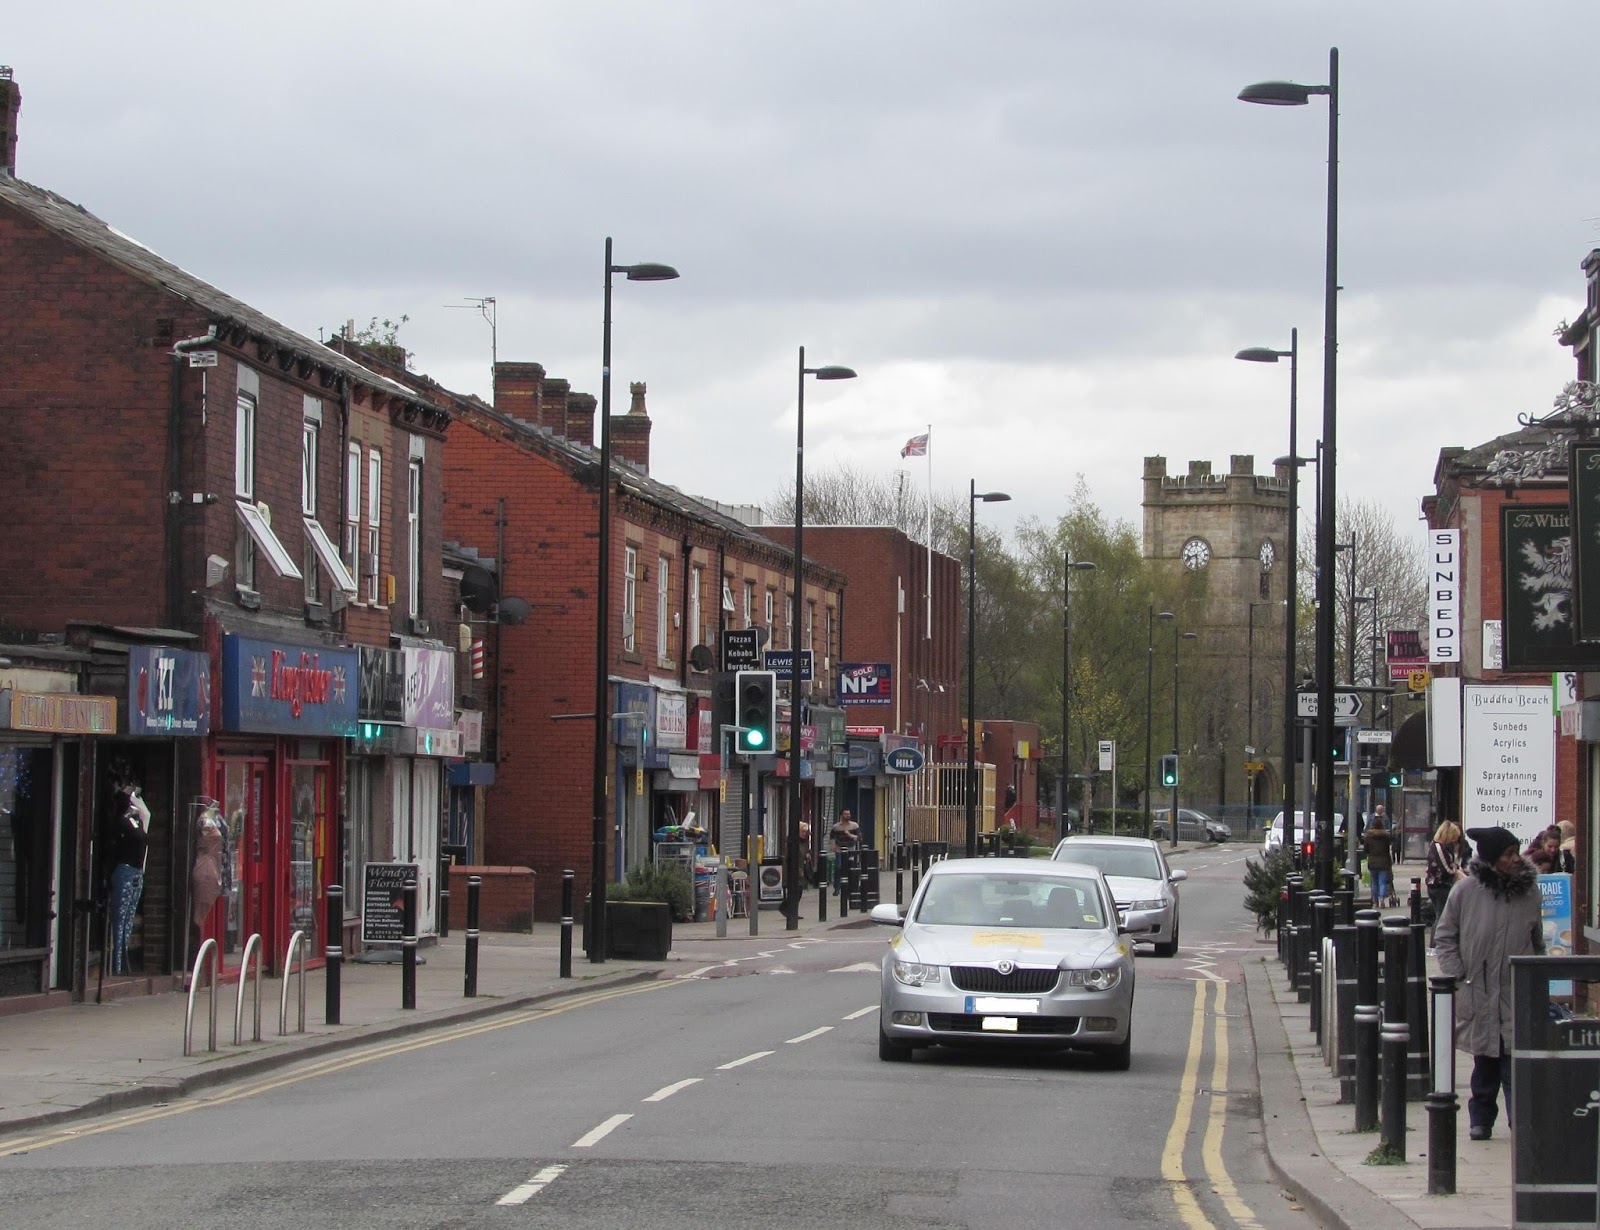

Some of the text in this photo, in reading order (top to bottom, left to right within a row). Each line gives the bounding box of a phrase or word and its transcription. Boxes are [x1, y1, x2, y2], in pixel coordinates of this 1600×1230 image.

[1513, 514, 1570, 528] The Whit
[1436, 533, 1454, 657] SUNBEDS
[767, 658, 793, 666] LEWIS
[852, 666, 873, 677] SOLD
[1471, 693, 1549, 707] Buddha Beach
[20, 694, 55, 728] RETRO
[1492, 722, 1528, 731] Sunbeds
[1493, 738, 1527, 749] Acrylics
[895, 758, 914, 768] HILL
[1500, 755, 1519, 764] Gels
[1482, 771, 1537, 782] Spraytanning
[1476, 787, 1506, 798] Waxing
[1514, 787, 1543, 798] Tinting
[1480, 803, 1504, 812] Botox
[1512, 803, 1539, 812] Fillers
[368, 866, 415, 880] Wendy's
[1569, 1029, 1600, 1046] Litt
